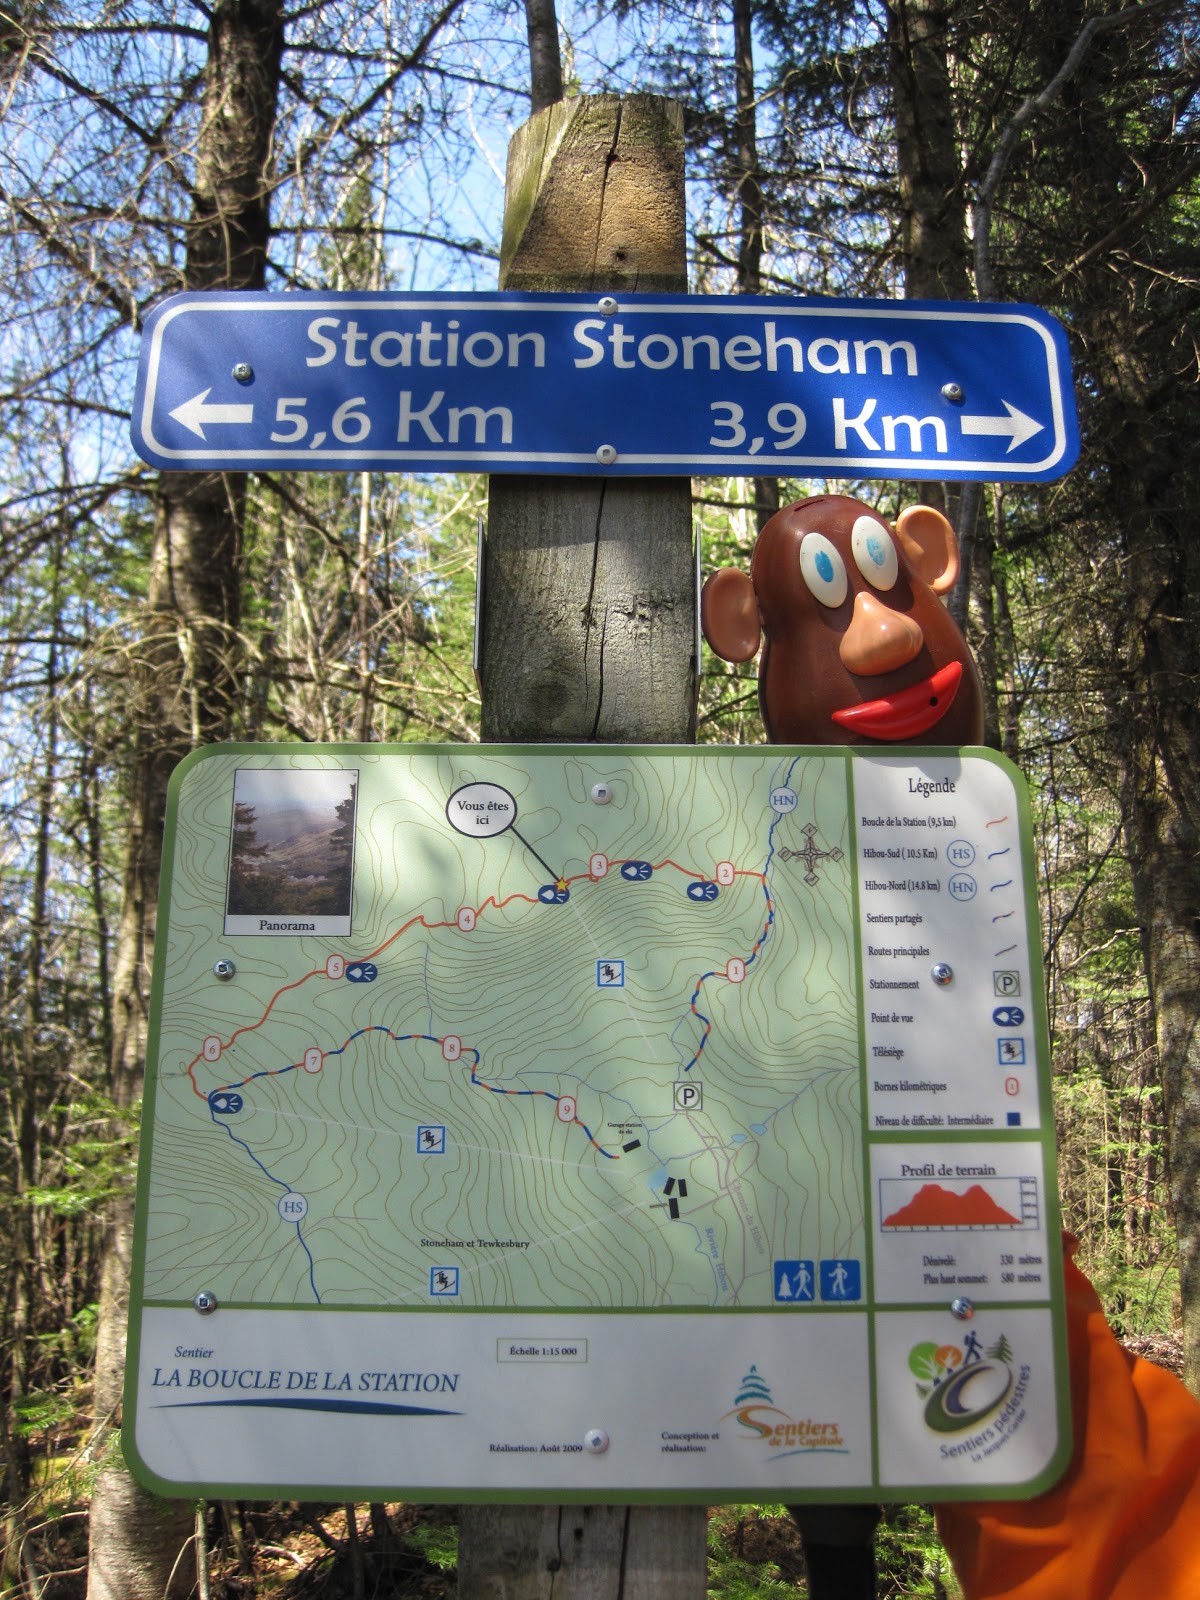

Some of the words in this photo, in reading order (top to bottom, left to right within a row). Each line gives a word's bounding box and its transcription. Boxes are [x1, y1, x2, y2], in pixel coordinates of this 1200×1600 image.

[306, 317, 545, 369] Station
[573, 318, 918, 376] Stoneham
[270, 396, 371, 449] 5,6
[398, 390, 514, 444] Km
[709, 400, 806, 456] 3,9
[834, 396, 948, 453] Km
[908, 777, 956, 798] Légende
[457, 800, 485, 811] Vous
[487, 801, 509, 811] êtes
[772, 796, 794, 806] HN
[476, 816, 489, 825] ici
[862, 817, 885, 827] Boucle
[886, 817, 895, 827] de
[896, 817, 902, 827] la
[903, 817, 927, 827] Station
[928, 816, 942, 828] (9,5
[942, 816, 956, 828] km)
[863, 848, 900, 859] Hibou-Sud
[922, 848, 938, 860] Km)
[952, 849, 970, 859] HS
[597, 861, 602, 870] 3
[722, 869, 730, 878] 2
[865, 880, 906, 891] Hibou-Nord
[908, 880, 926, 892] (14.8
[927, 880, 941, 892] km)
[952, 882, 974, 893] HN
[464, 915, 471, 924] 4
[866, 913, 894, 924] Sentiers
[895, 914, 923, 926] partagés
[259, 919, 316, 932] Panorama
[868, 946, 892, 956] Routes
[894, 946, 930, 958] principales
[333, 962, 340, 972] 5
[734, 966, 738, 974] 1
[870, 979, 920, 990] Stationnement
[1002, 976, 1013, 992] P
[871, 1012, 890, 1023] Point
[892, 1012, 900, 1023] de
[901, 1015, 914, 1023] vue
[209, 1044, 216, 1054] 6
[449, 1044, 455, 1053] 8
[873, 1046, 904, 1060] Télésiège
[310, 1056, 318, 1066] 7
[874, 1082, 898, 1092] Bornes
[900, 1080, 947, 1094] kilométriques
[683, 1088, 695, 1105] P
[564, 1104, 570, 1114] 9
[876, 1116, 900, 1126] Niveau
[902, 1116, 910, 1126] de
[901, 1164, 935, 1177] Profil
[938, 1164, 953, 1176] de
[956, 1164, 996, 1176] terrain
[283, 1202, 304, 1214] HS
[420, 1238, 464, 1248] Stoneham
[466, 1240, 475, 1248] et
[476, 1240, 530, 1250] Tewkesbury
[174, 1346, 214, 1358] Sentier
[510, 1346, 540, 1356] Échelle
[542, 1348, 560, 1356] 1:15
[561, 1348, 578, 1356] 000
[152, 1368, 184, 1387] LA
[186, 1369, 282, 1390] BOUCLE
[285, 1371, 318, 1390] DE
[322, 1372, 352, 1391] LA
[358, 1372, 460, 1393] STATION
[737, 1405, 839, 1438] Sentiers
[661, 1431, 710, 1442] Conception
[712, 1432, 720, 1440] et
[768, 1436, 780, 1446] de
[490, 1444, 538, 1452] Réalisation:
[540, 1444, 561, 1452] Août
[562, 1444, 583, 1452] 2009
[661, 1443, 706, 1453] réalisation:
[940, 1428, 995, 1458] Sentiers
